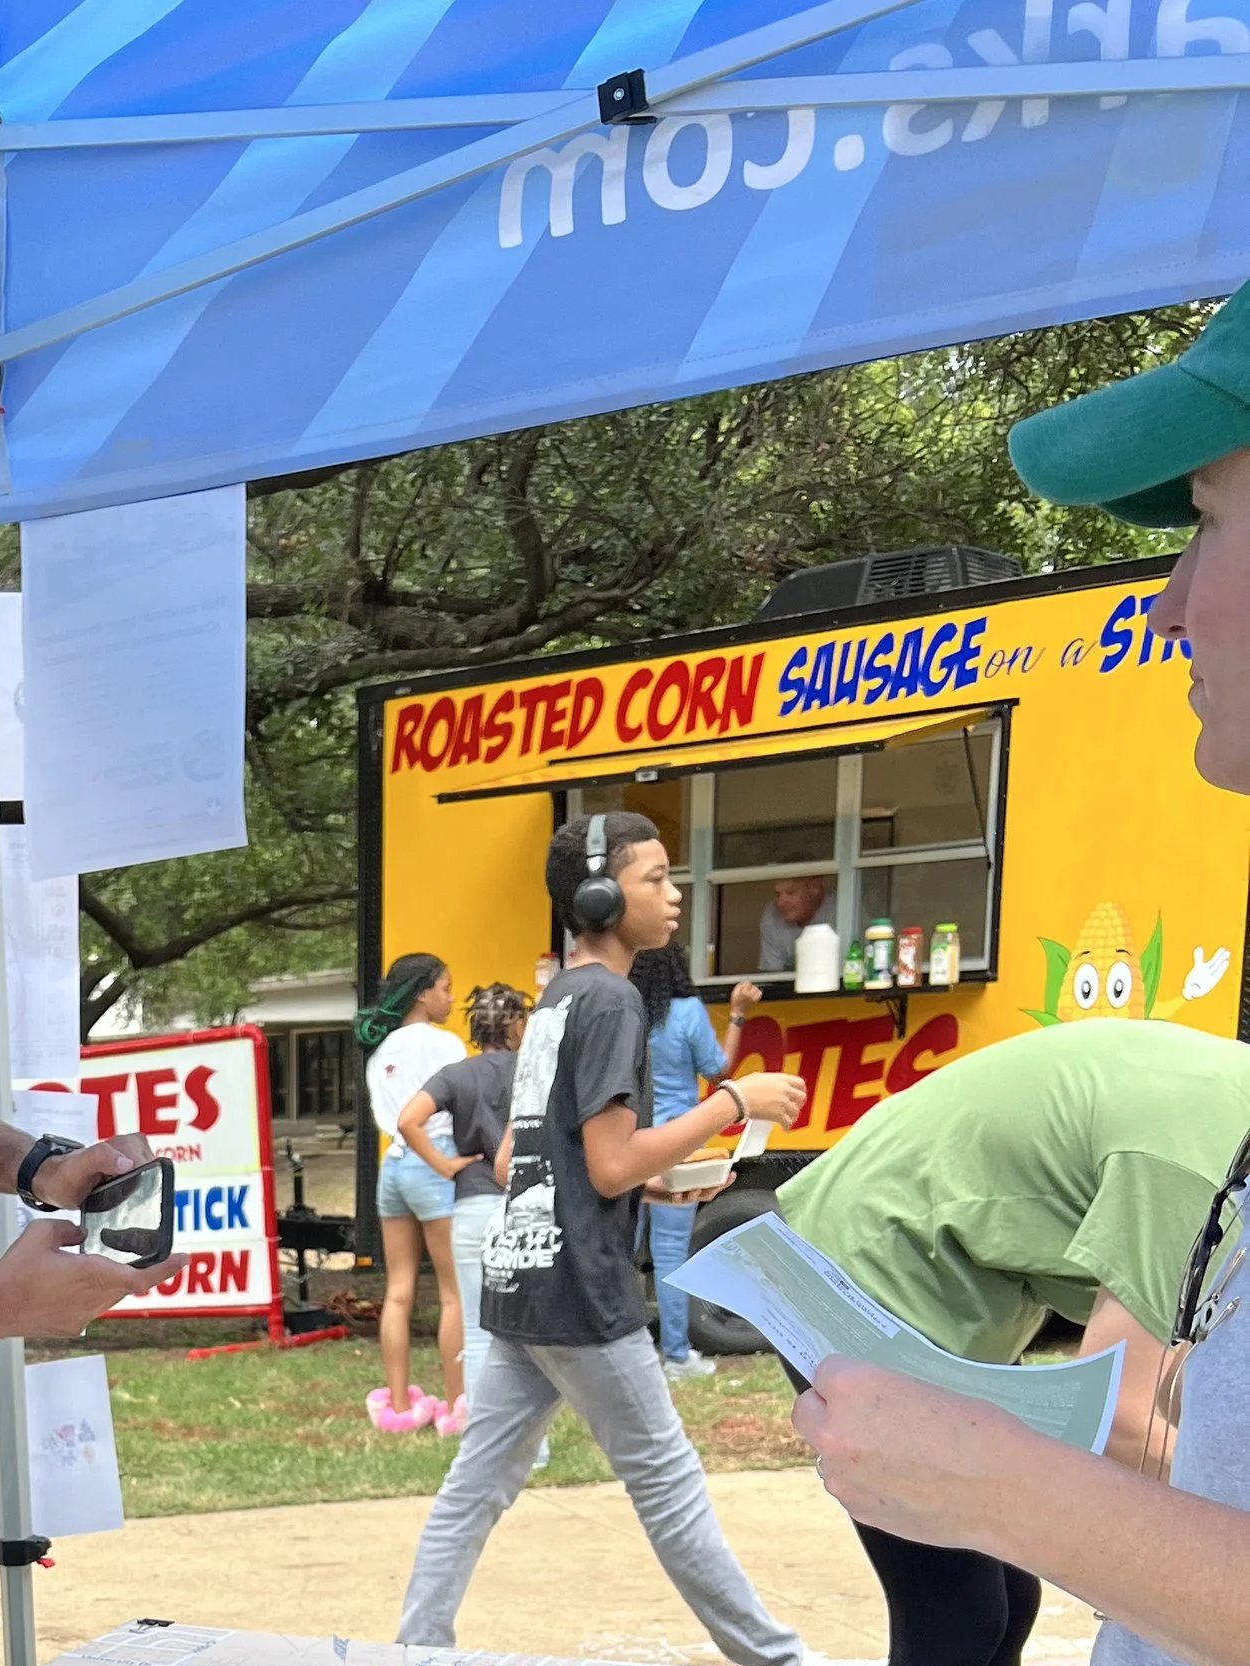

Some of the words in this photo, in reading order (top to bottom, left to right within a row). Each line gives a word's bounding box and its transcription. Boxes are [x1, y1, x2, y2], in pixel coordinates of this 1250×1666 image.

[391, 676, 605, 775] ROASTED
[615, 651, 766, 744] CORN
[777, 616, 988, 718] SAUSAGE
[983, 646, 1046, 680] on
[1060, 637, 1098, 670] a
[1098, 594, 1192, 674] ST
